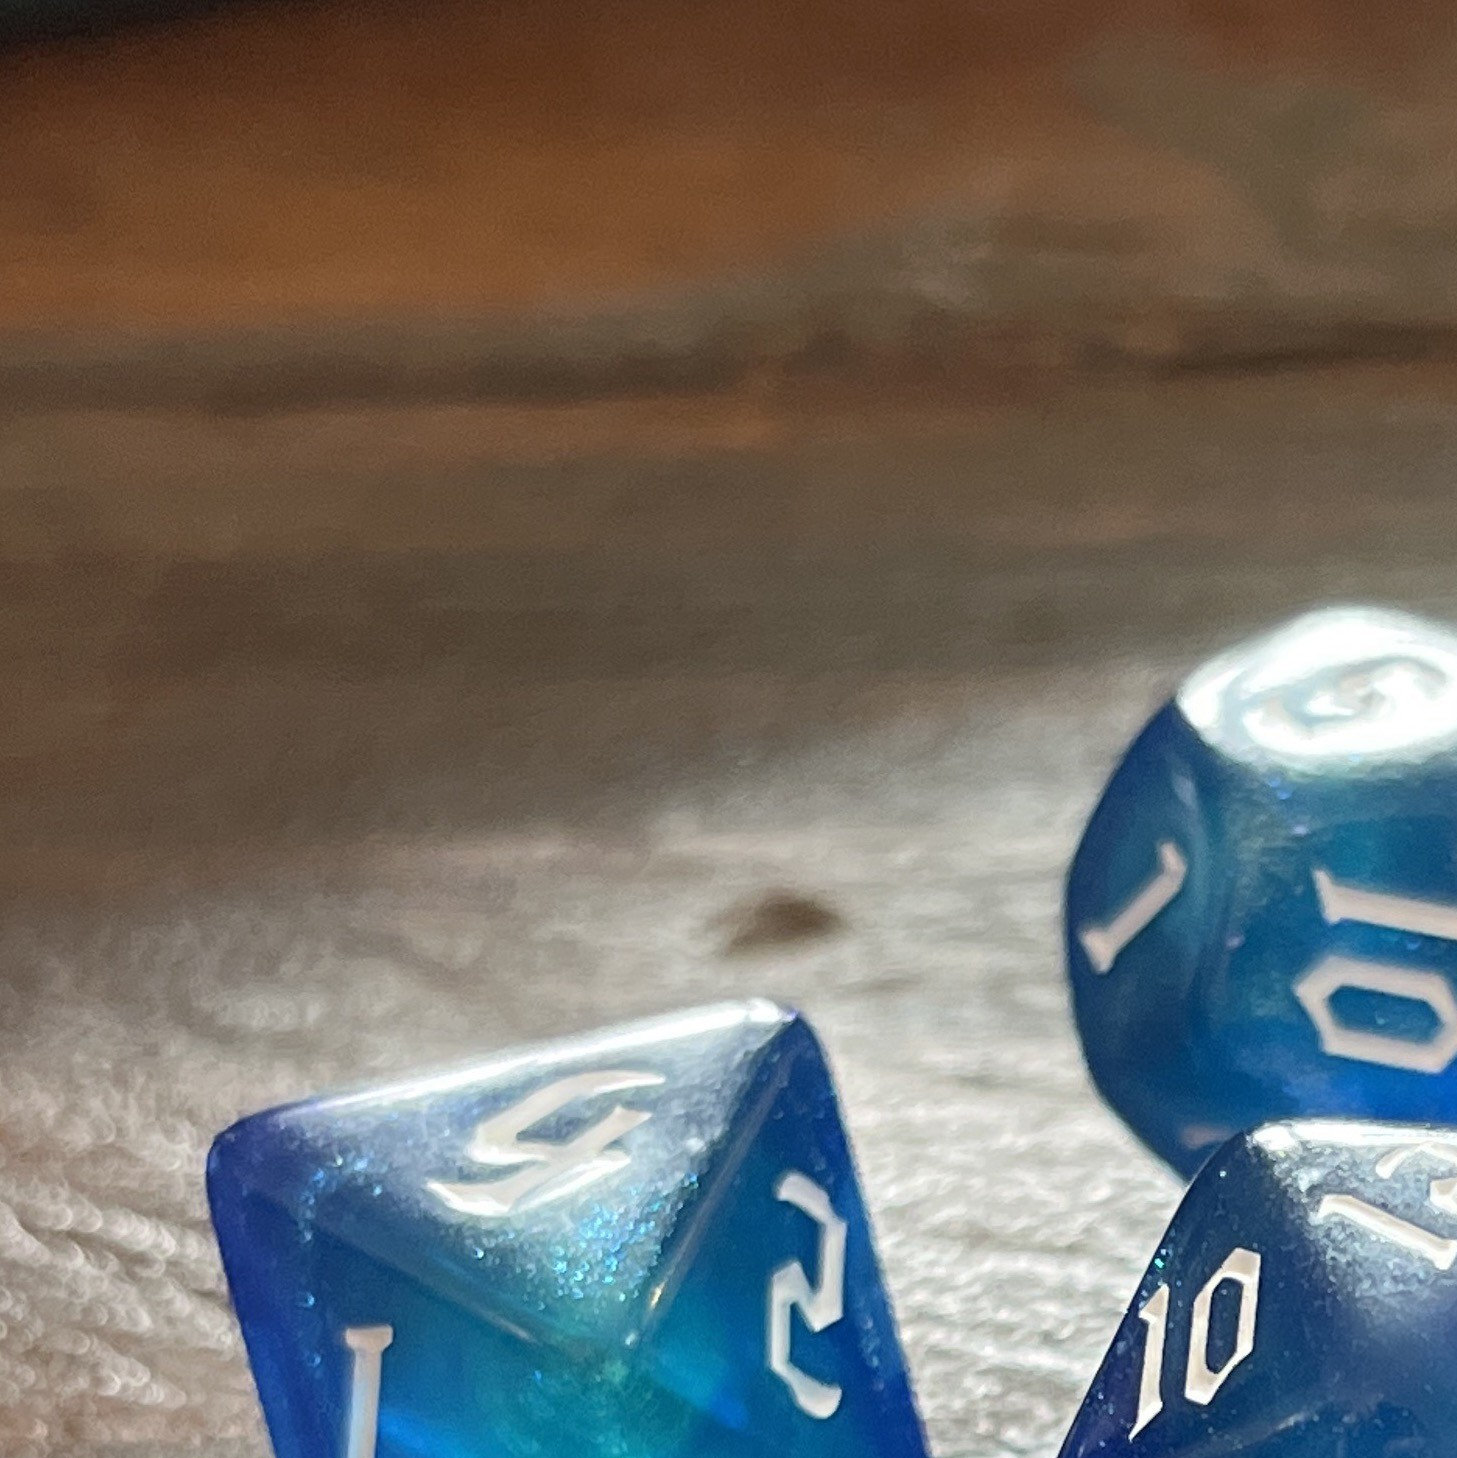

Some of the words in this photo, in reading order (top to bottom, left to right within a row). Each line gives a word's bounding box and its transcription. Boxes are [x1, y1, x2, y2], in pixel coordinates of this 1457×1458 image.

[1079, 841, 1188, 973] 1
[769, 1171, 847, 1419] 2
[1128, 1247, 1262, 1442] 10
